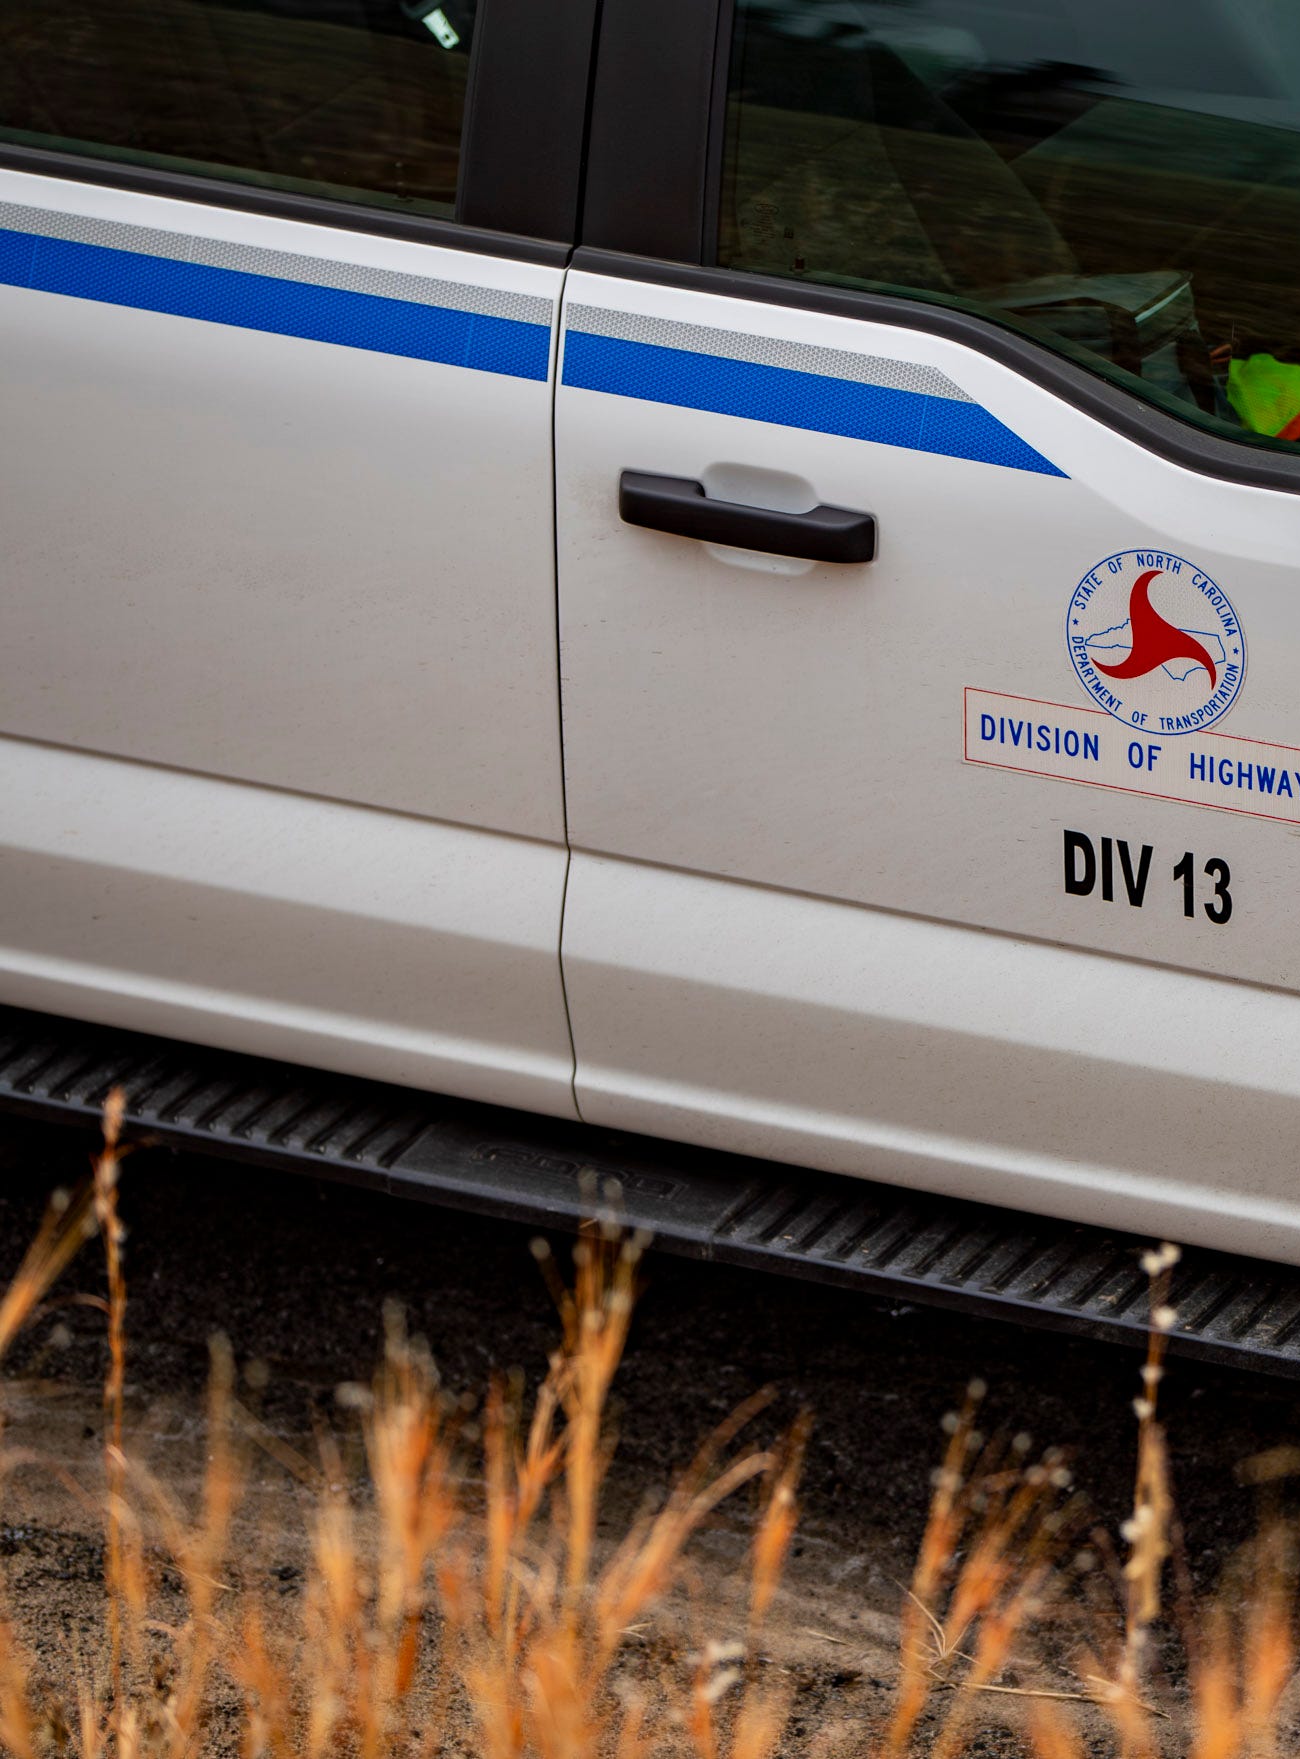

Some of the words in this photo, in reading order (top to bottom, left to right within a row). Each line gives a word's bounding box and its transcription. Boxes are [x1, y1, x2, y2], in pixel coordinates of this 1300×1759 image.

[1075, 573, 1103, 610] STATE
[1107, 557, 1123, 574] OF
[1136, 553, 1182, 575] NORTH
[1191, 573, 1238, 637] CAROLINA
[1071, 636, 1123, 712] DEPARTMENT
[1131, 711, 1148, 726] OF
[1159, 663, 1240, 731] TRANSPORTATION
[980, 713, 1100, 762] DIVISION
[1127, 741, 1162, 771] OF
[1063, 829, 1154, 908] DIV
[1173, 851, 1233, 925] 13
